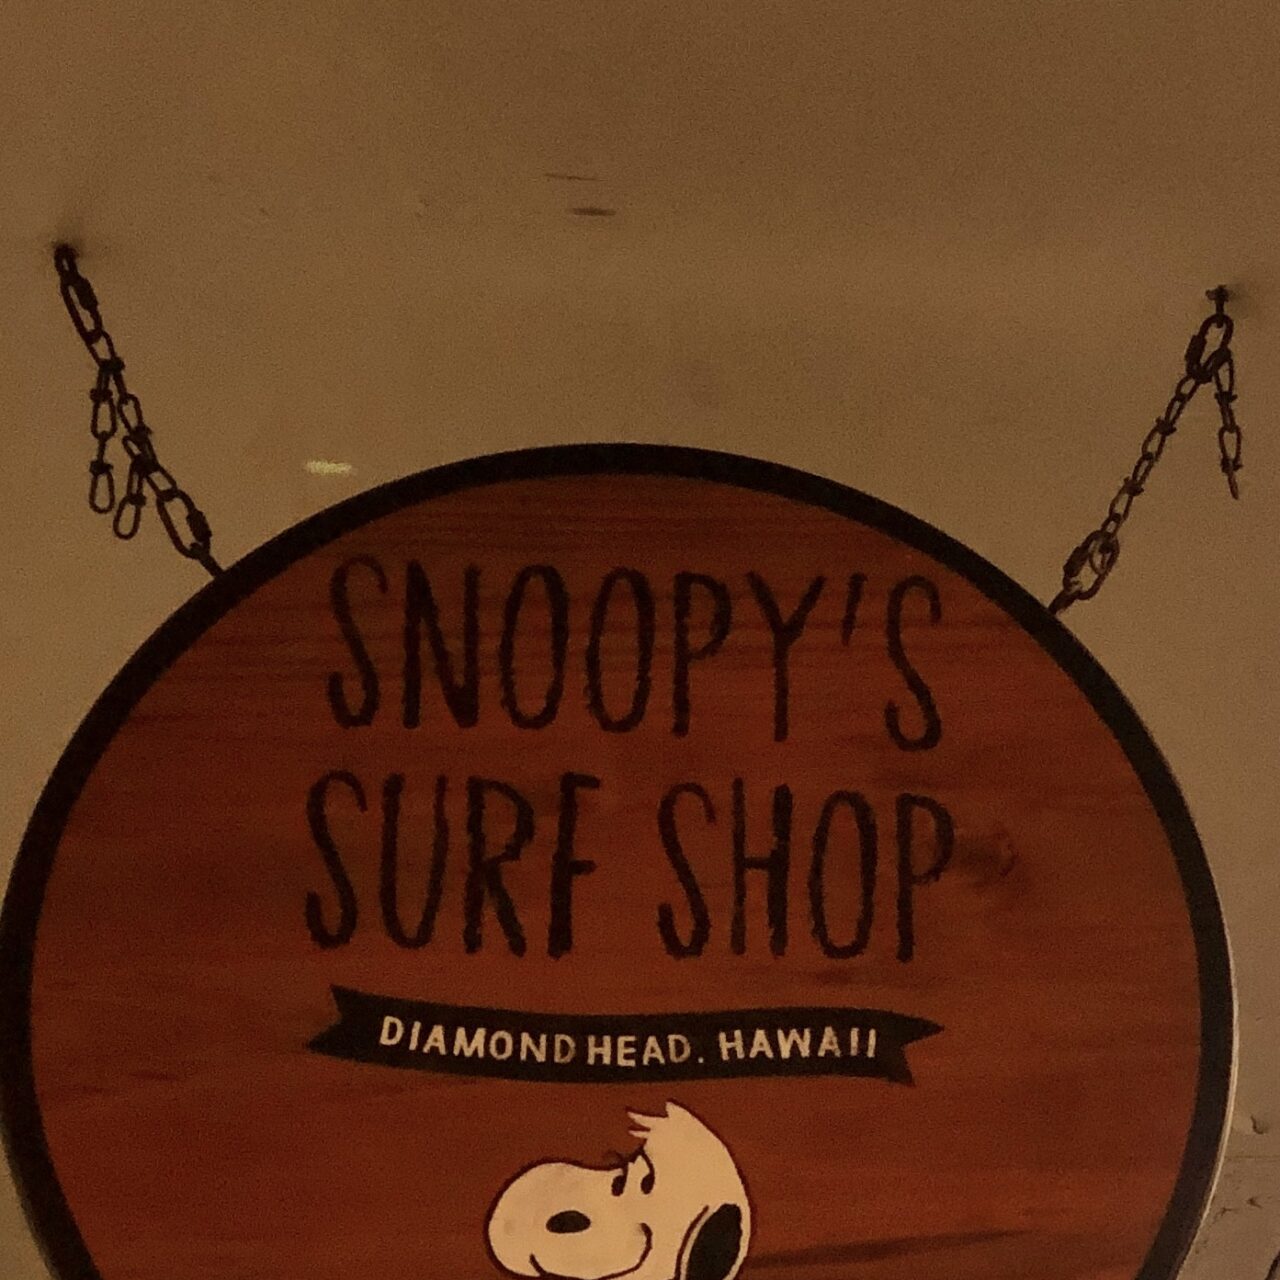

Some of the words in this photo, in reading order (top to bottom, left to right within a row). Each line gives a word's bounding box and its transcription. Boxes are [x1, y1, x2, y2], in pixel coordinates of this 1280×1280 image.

[327, 555, 943, 752] SNOOPY'S
[304, 769, 600, 961] SURF
[656, 776, 956, 965] SHOP
[379, 1015, 576, 1065] DIAMOND
[718, 1026, 877, 1061] HAWAII
